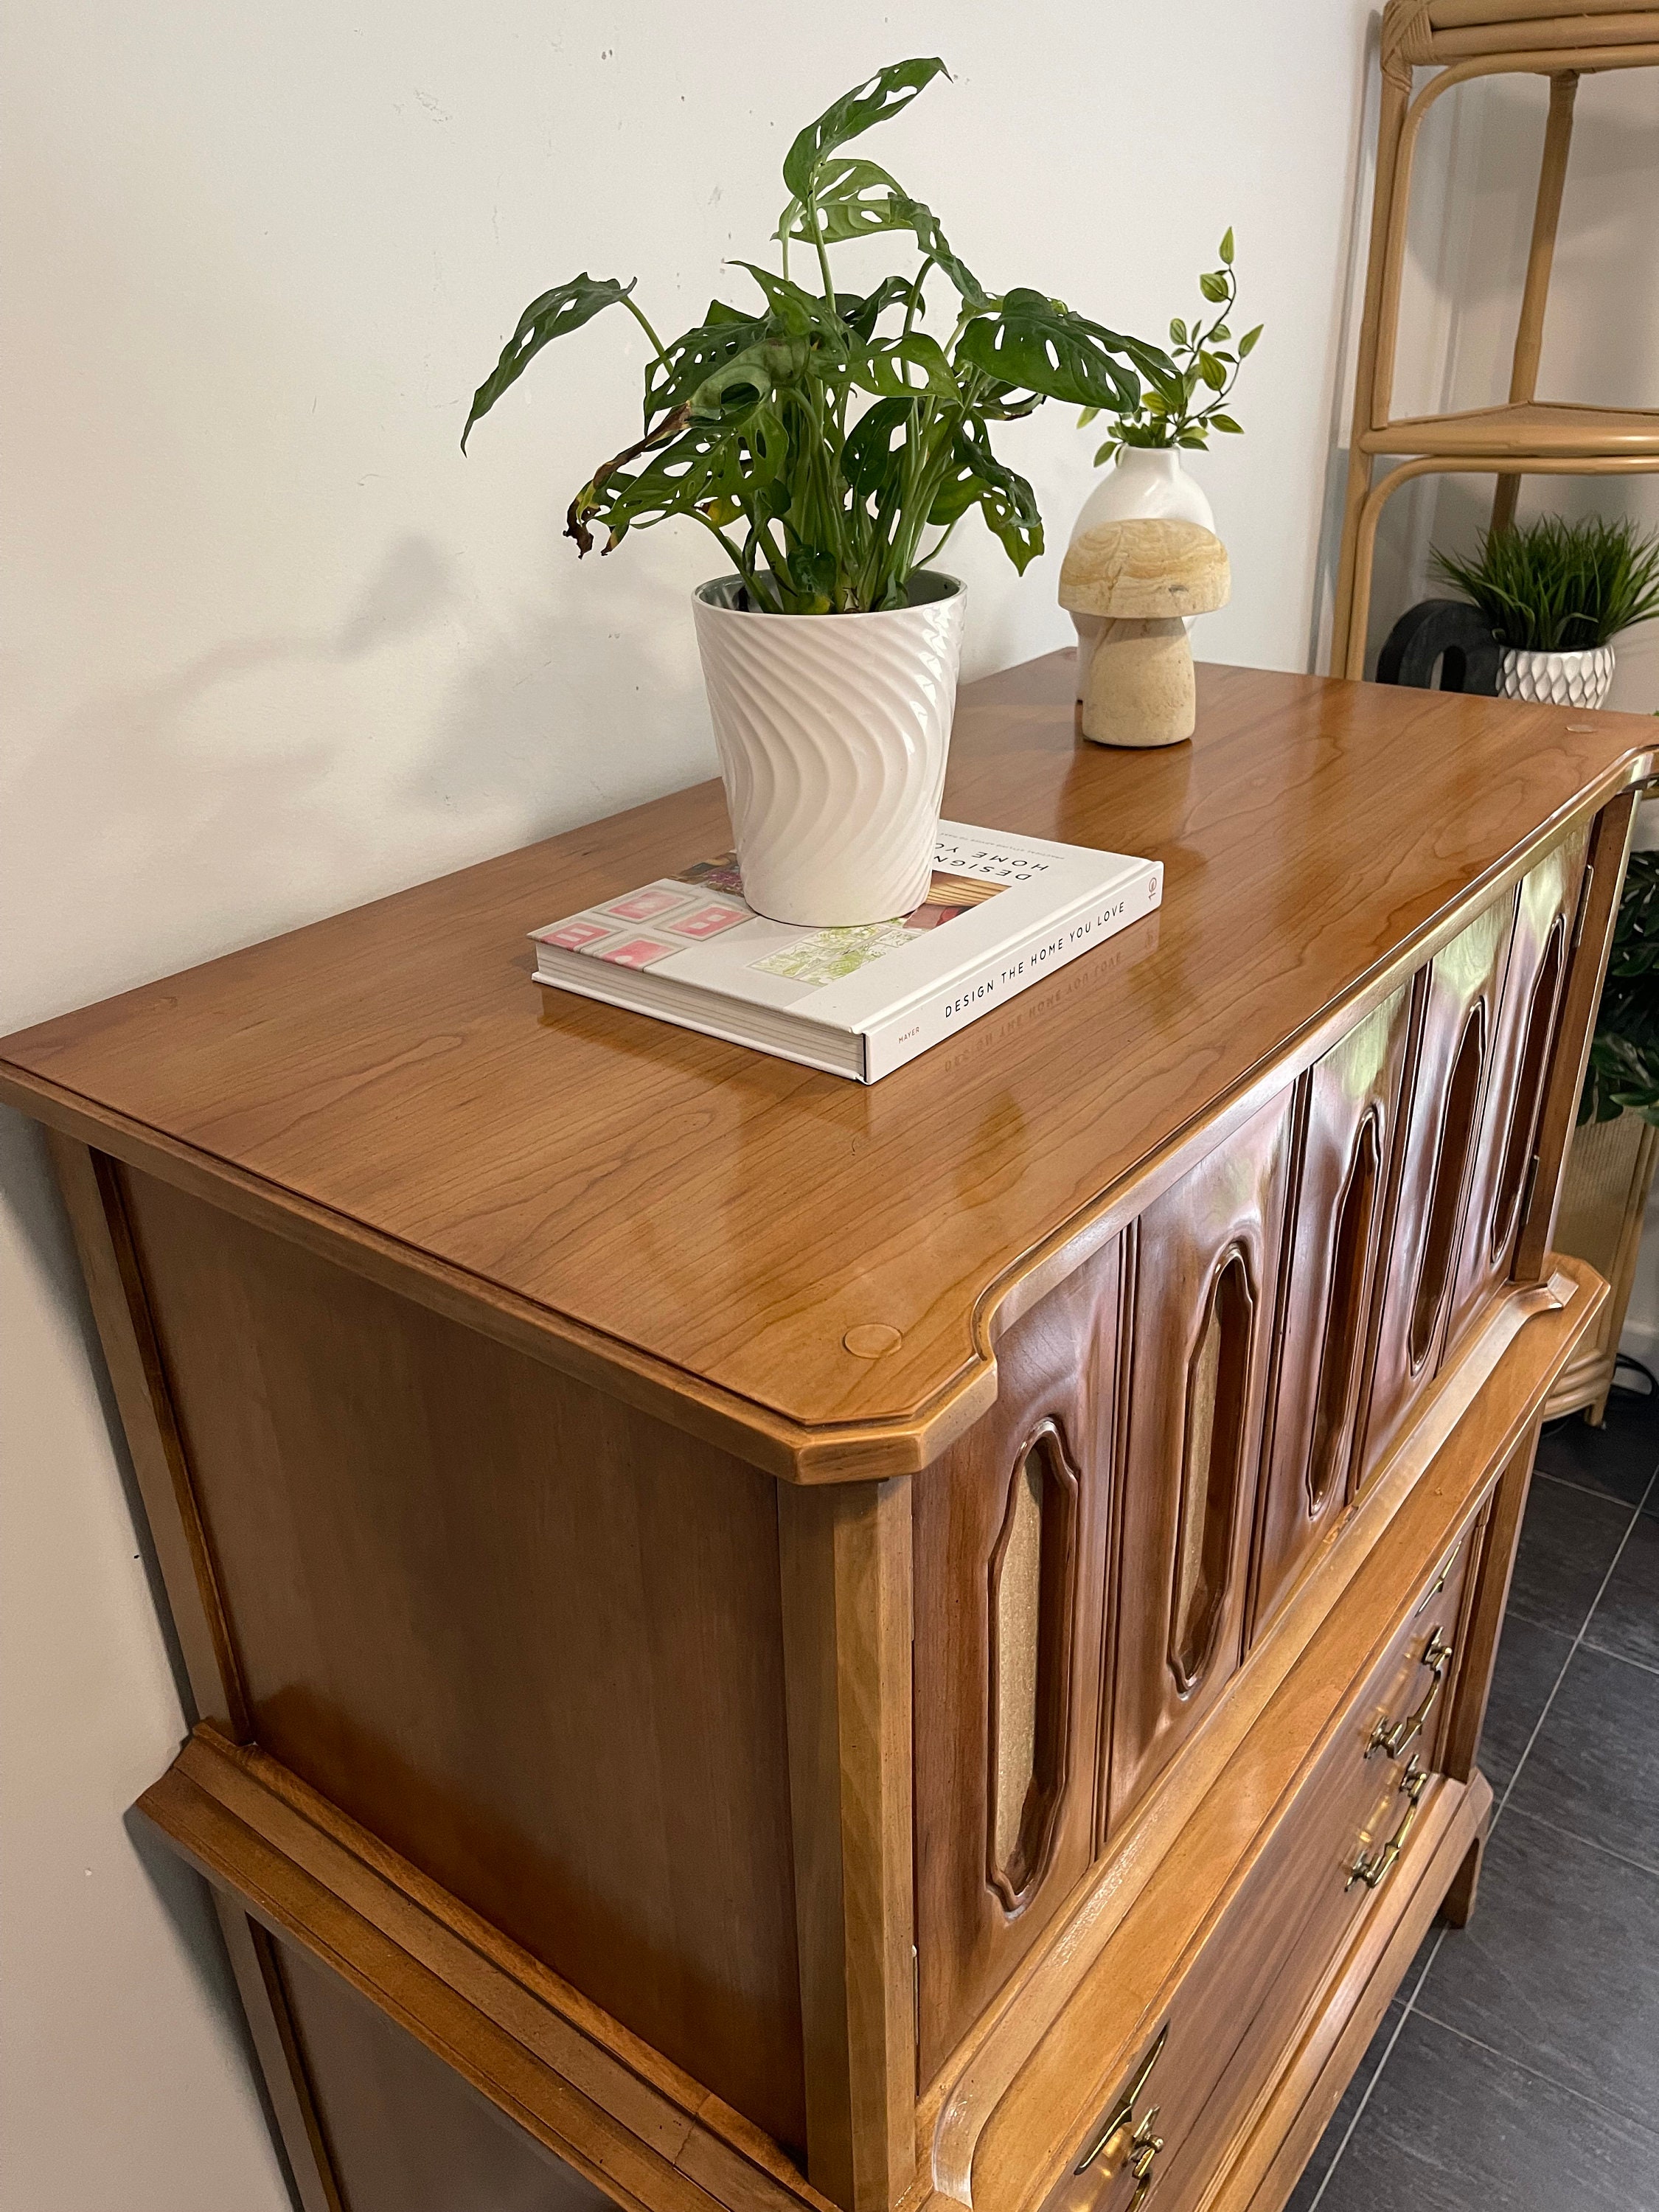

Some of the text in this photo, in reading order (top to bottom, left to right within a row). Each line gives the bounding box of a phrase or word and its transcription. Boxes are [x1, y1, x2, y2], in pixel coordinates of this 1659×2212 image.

[933, 855, 1032, 880] DESIGN
[935, 843, 1049, 871] HOME YO
[945, 901, 1124, 1018] DESIGN THE HOME YOU LOVE
[898, 1026, 920, 1044] MAYER
